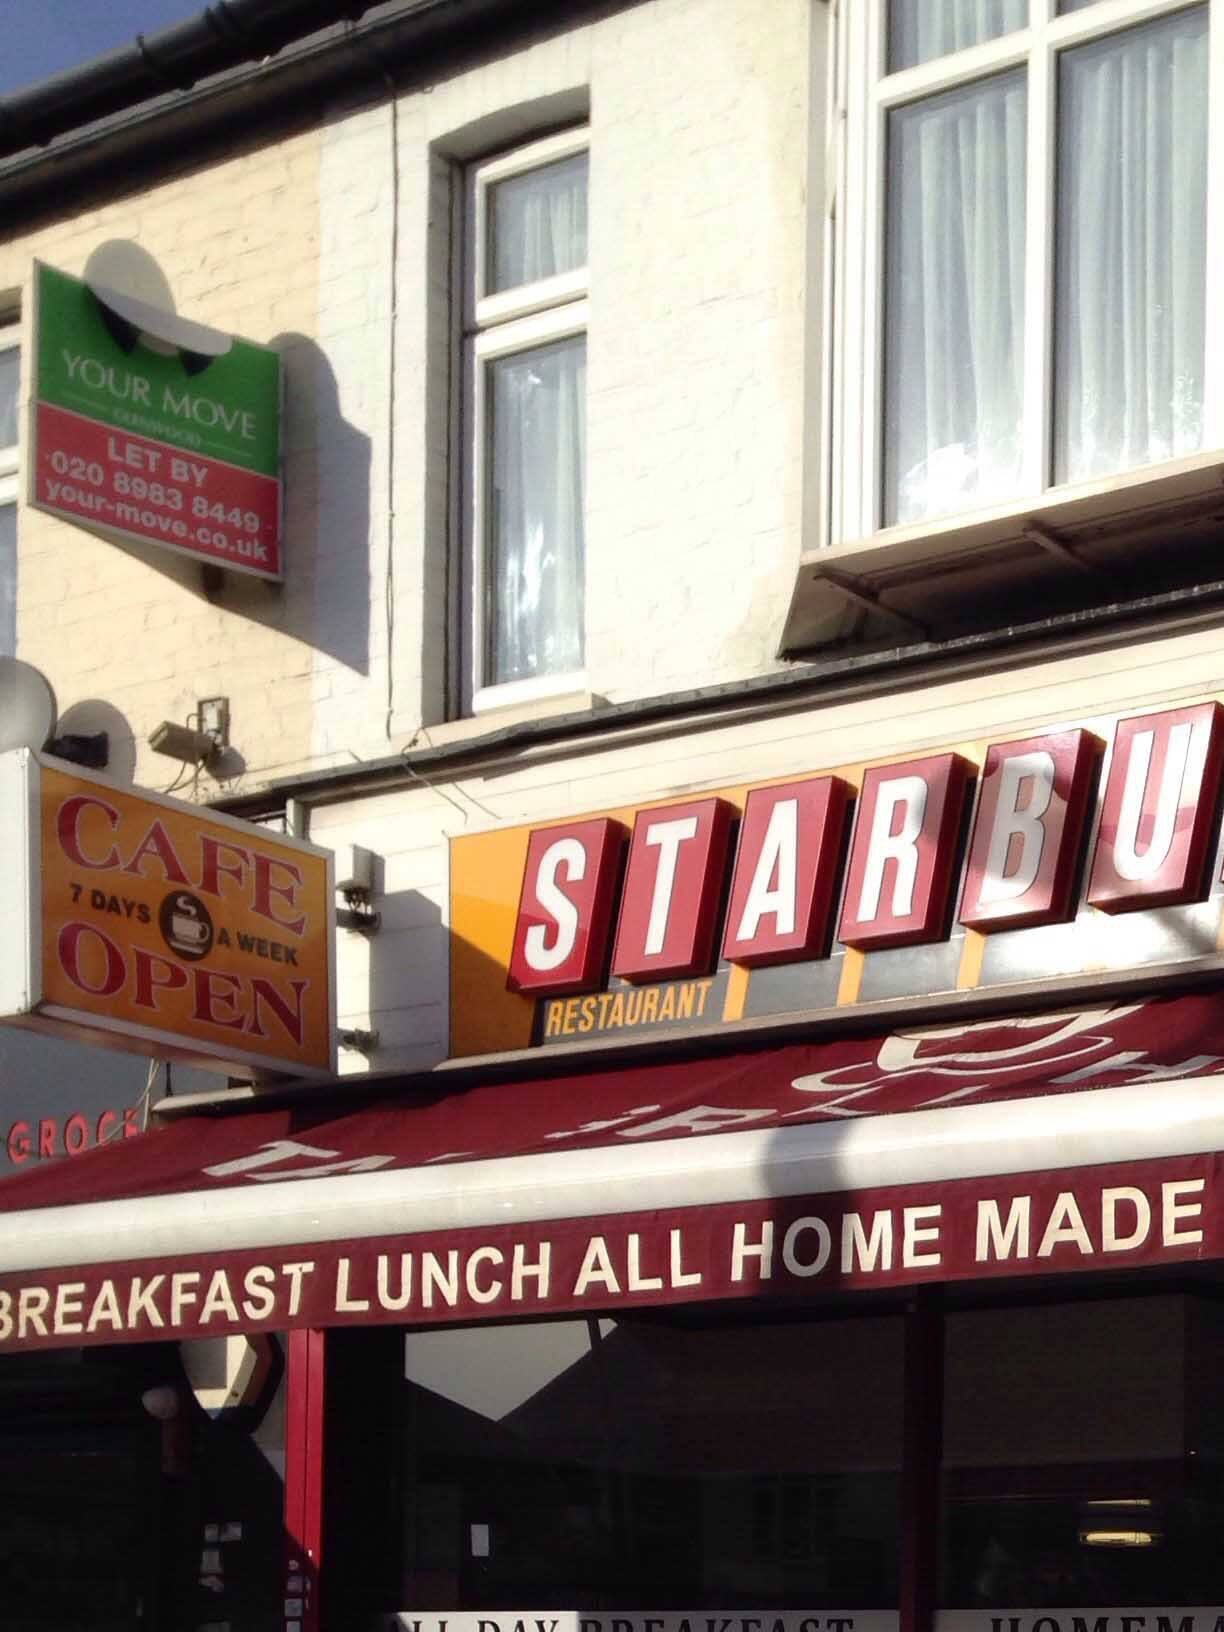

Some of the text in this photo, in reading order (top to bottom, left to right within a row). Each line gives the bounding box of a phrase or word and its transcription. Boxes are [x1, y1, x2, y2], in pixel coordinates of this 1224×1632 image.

[62, 349, 151, 407] YOUR
[162, 387, 257, 441] MOVE
[51, 450, 261, 534] 020 8983 8449
[107, 436, 208, 488] LET BY
[45, 479, 268, 562] your-move.co.uk
[56, 793, 306, 936] CAFE
[68, 882, 299, 967] 7 DAYS A WEEK
[57, 919, 311, 1048] OPEN
[545, 979, 713, 1037] RESTAURANT
[334, 1235, 551, 1312] LUNCH
[572, 1228, 703, 1297] ALL
[729, 1203, 942, 1284] HOME
[974, 1178, 1205, 1263] MADE
